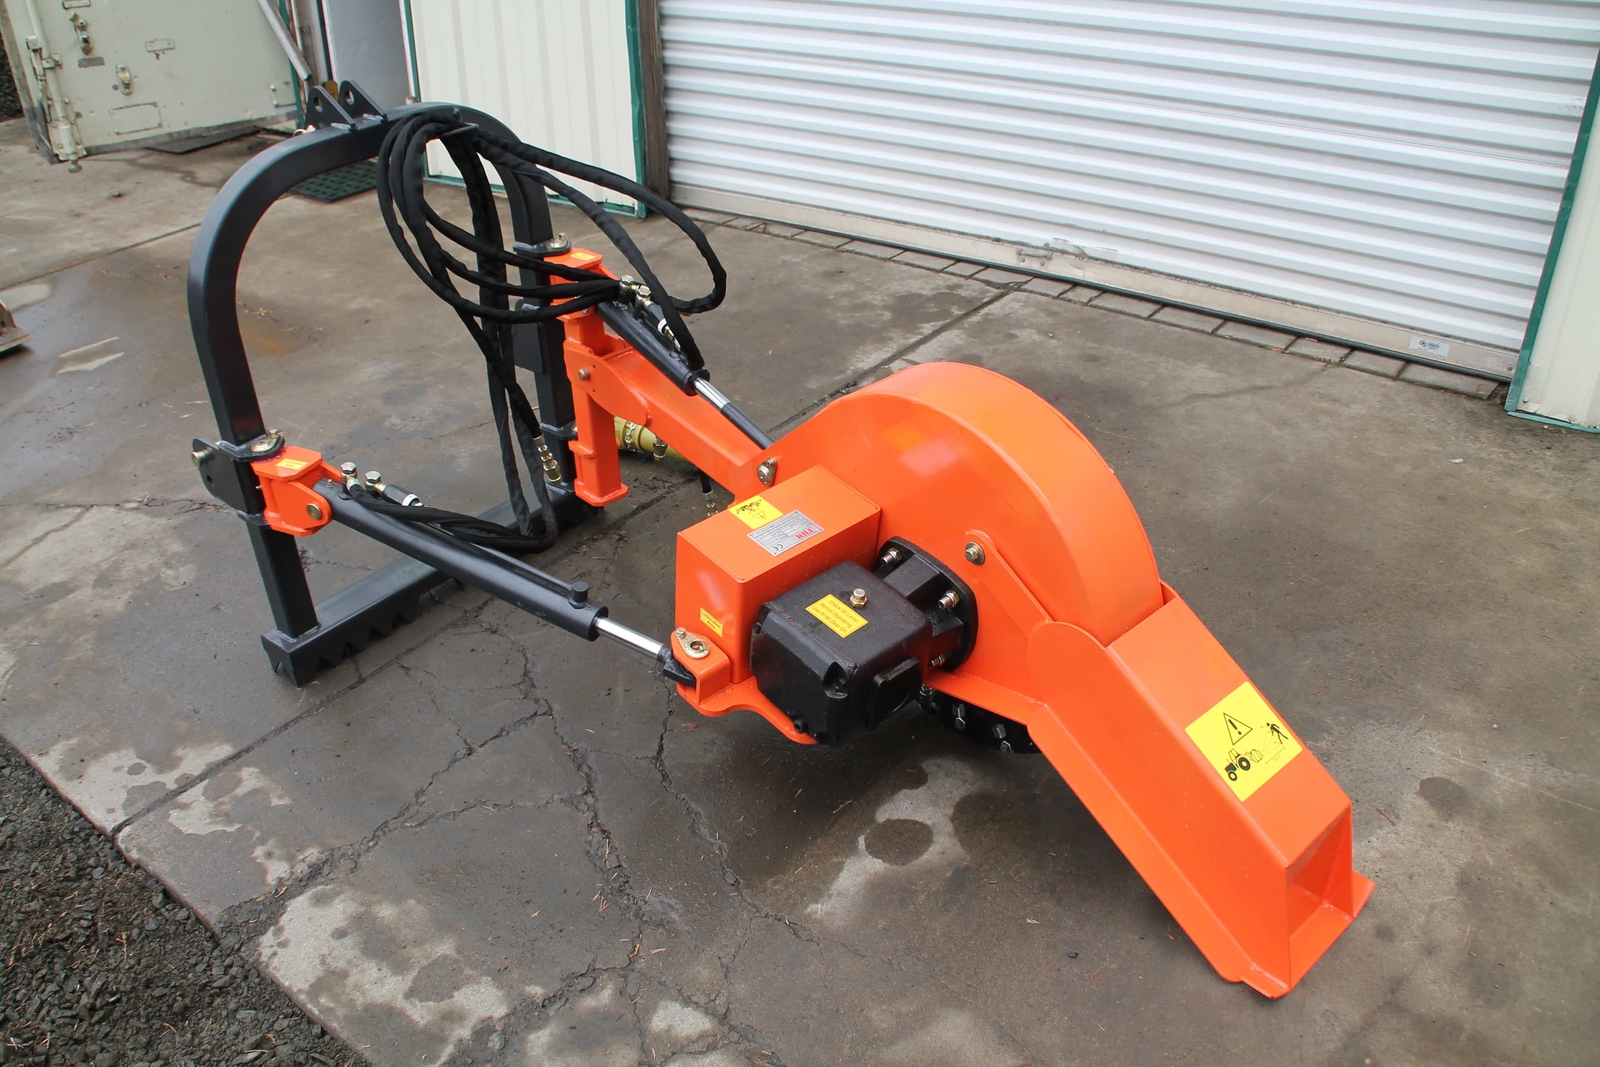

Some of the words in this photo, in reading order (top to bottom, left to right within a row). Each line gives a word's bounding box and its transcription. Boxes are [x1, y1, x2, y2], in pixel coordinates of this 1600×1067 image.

[820, 602, 833, 613] Before
[829, 600, 841, 611] Check
[847, 613, 859, 623] Level
[830, 619, 841, 628] Gear
